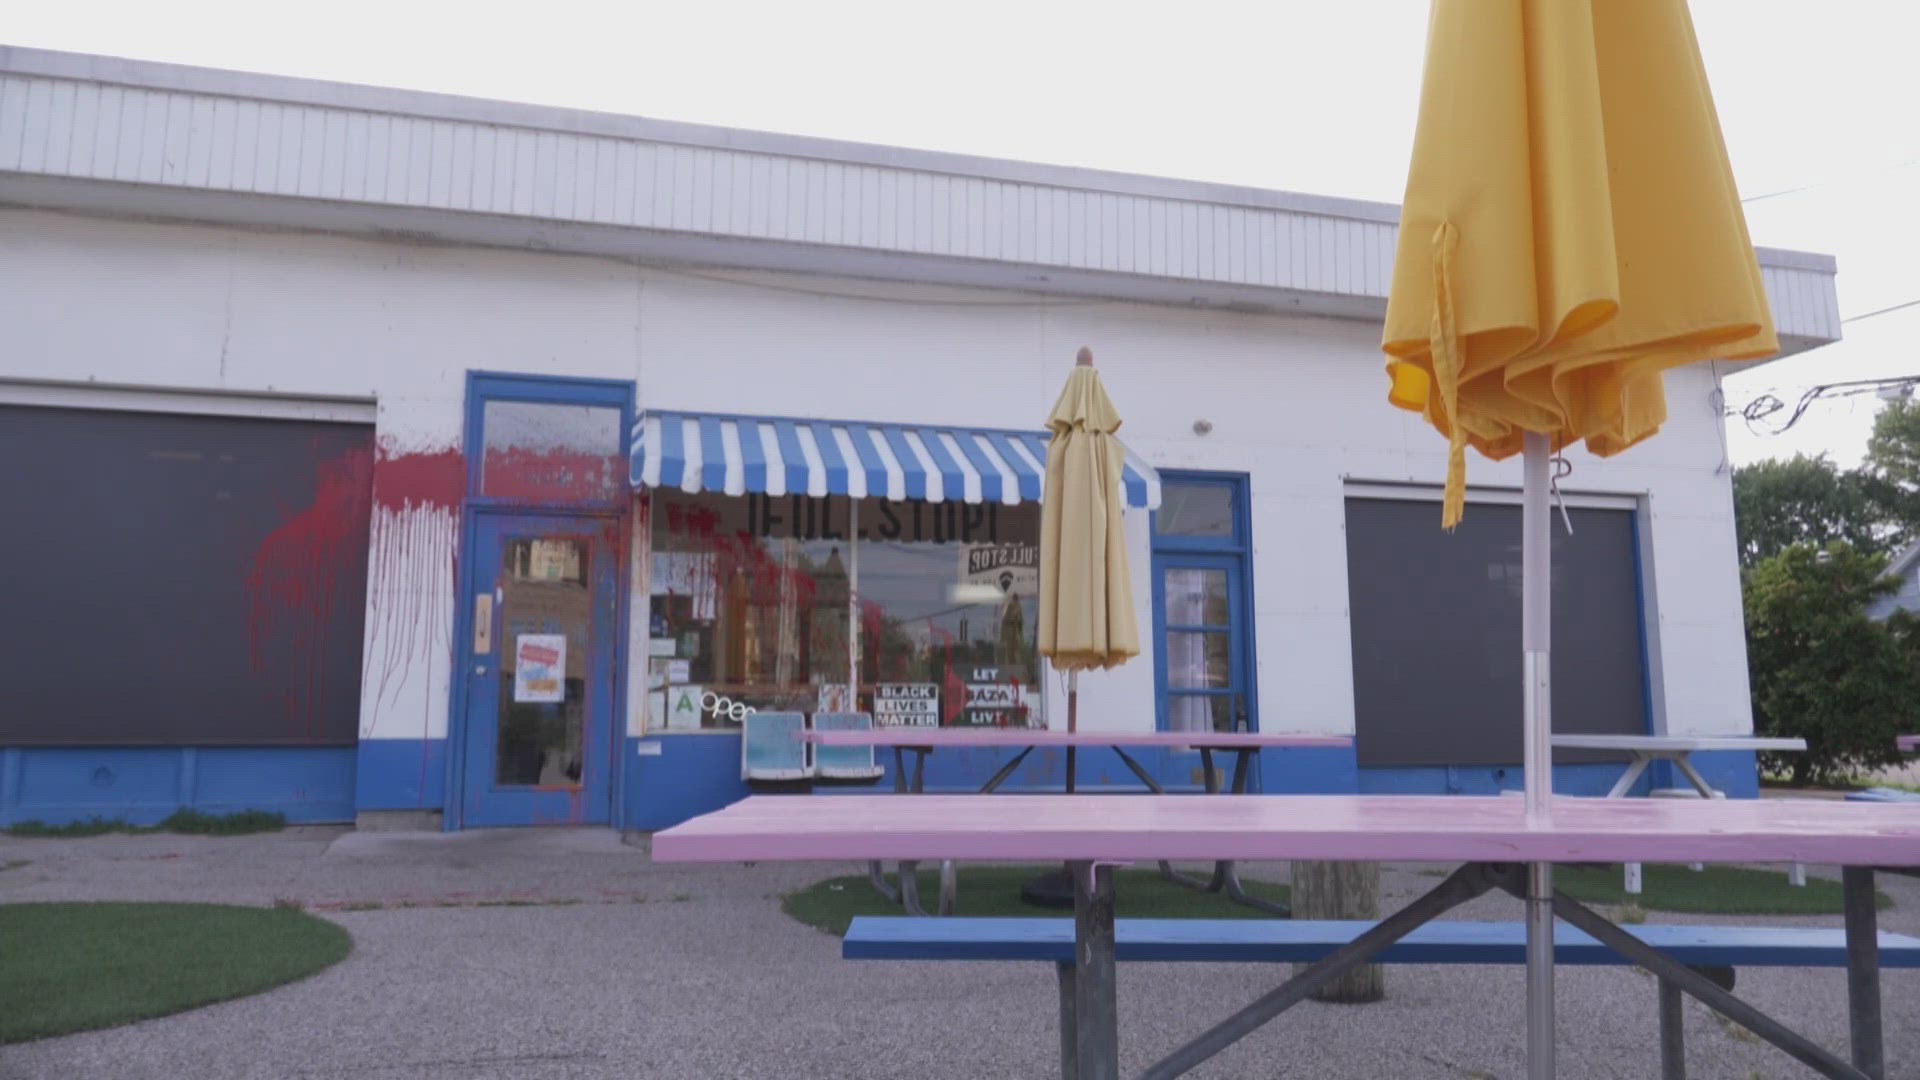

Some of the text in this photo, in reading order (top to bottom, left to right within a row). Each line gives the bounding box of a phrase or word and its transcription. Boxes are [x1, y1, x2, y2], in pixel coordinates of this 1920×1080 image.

[762, 492, 869, 540] FUL
[973, 668, 999, 681] LET
[881, 685, 930, 698] BLACK
[676, 692, 694, 713] A
[884, 701, 928, 712] LIVES
[877, 714, 936, 727] MATTER
